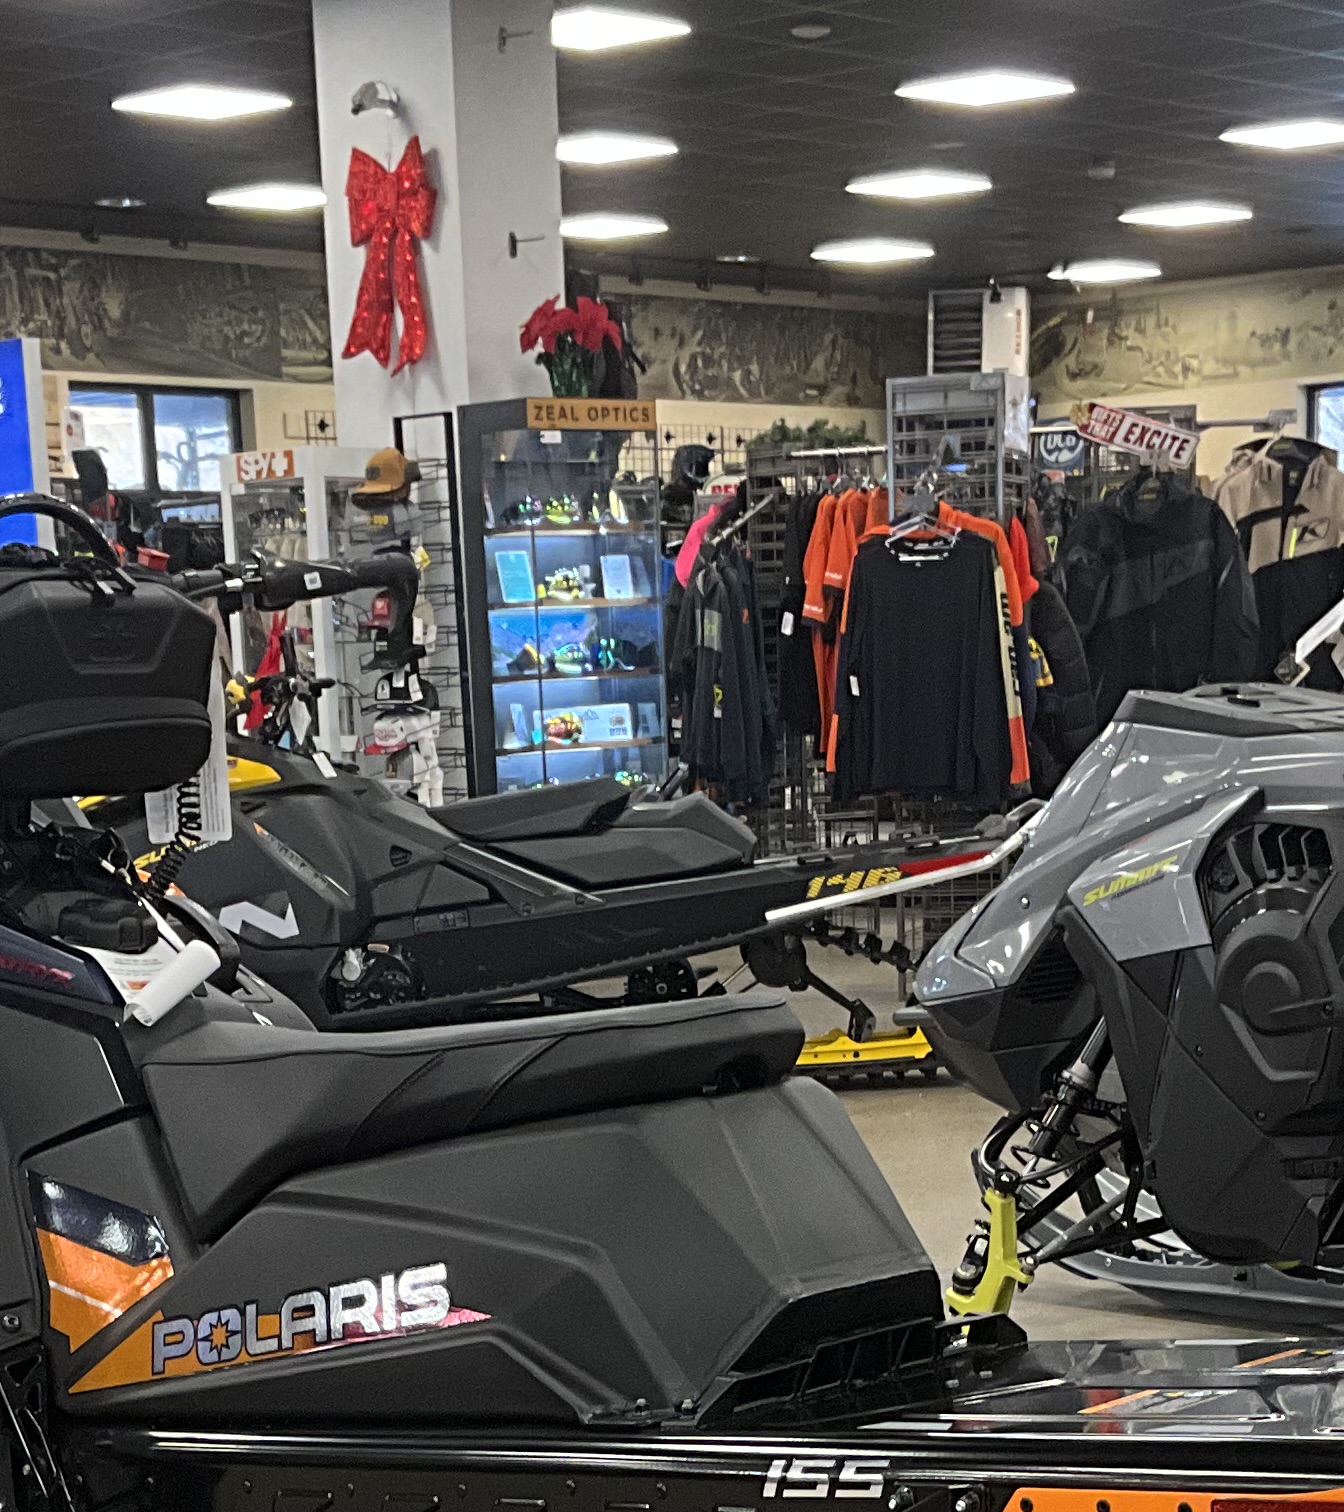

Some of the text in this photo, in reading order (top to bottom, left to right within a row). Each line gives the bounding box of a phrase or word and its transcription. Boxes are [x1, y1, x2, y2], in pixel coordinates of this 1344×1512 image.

[533, 405, 651, 423] ZEAL OPTICS
[1122, 422, 1191, 461] EXCITE
[151, 1261, 452, 1375] POLARIS
[762, 1457, 892, 1500] 155
